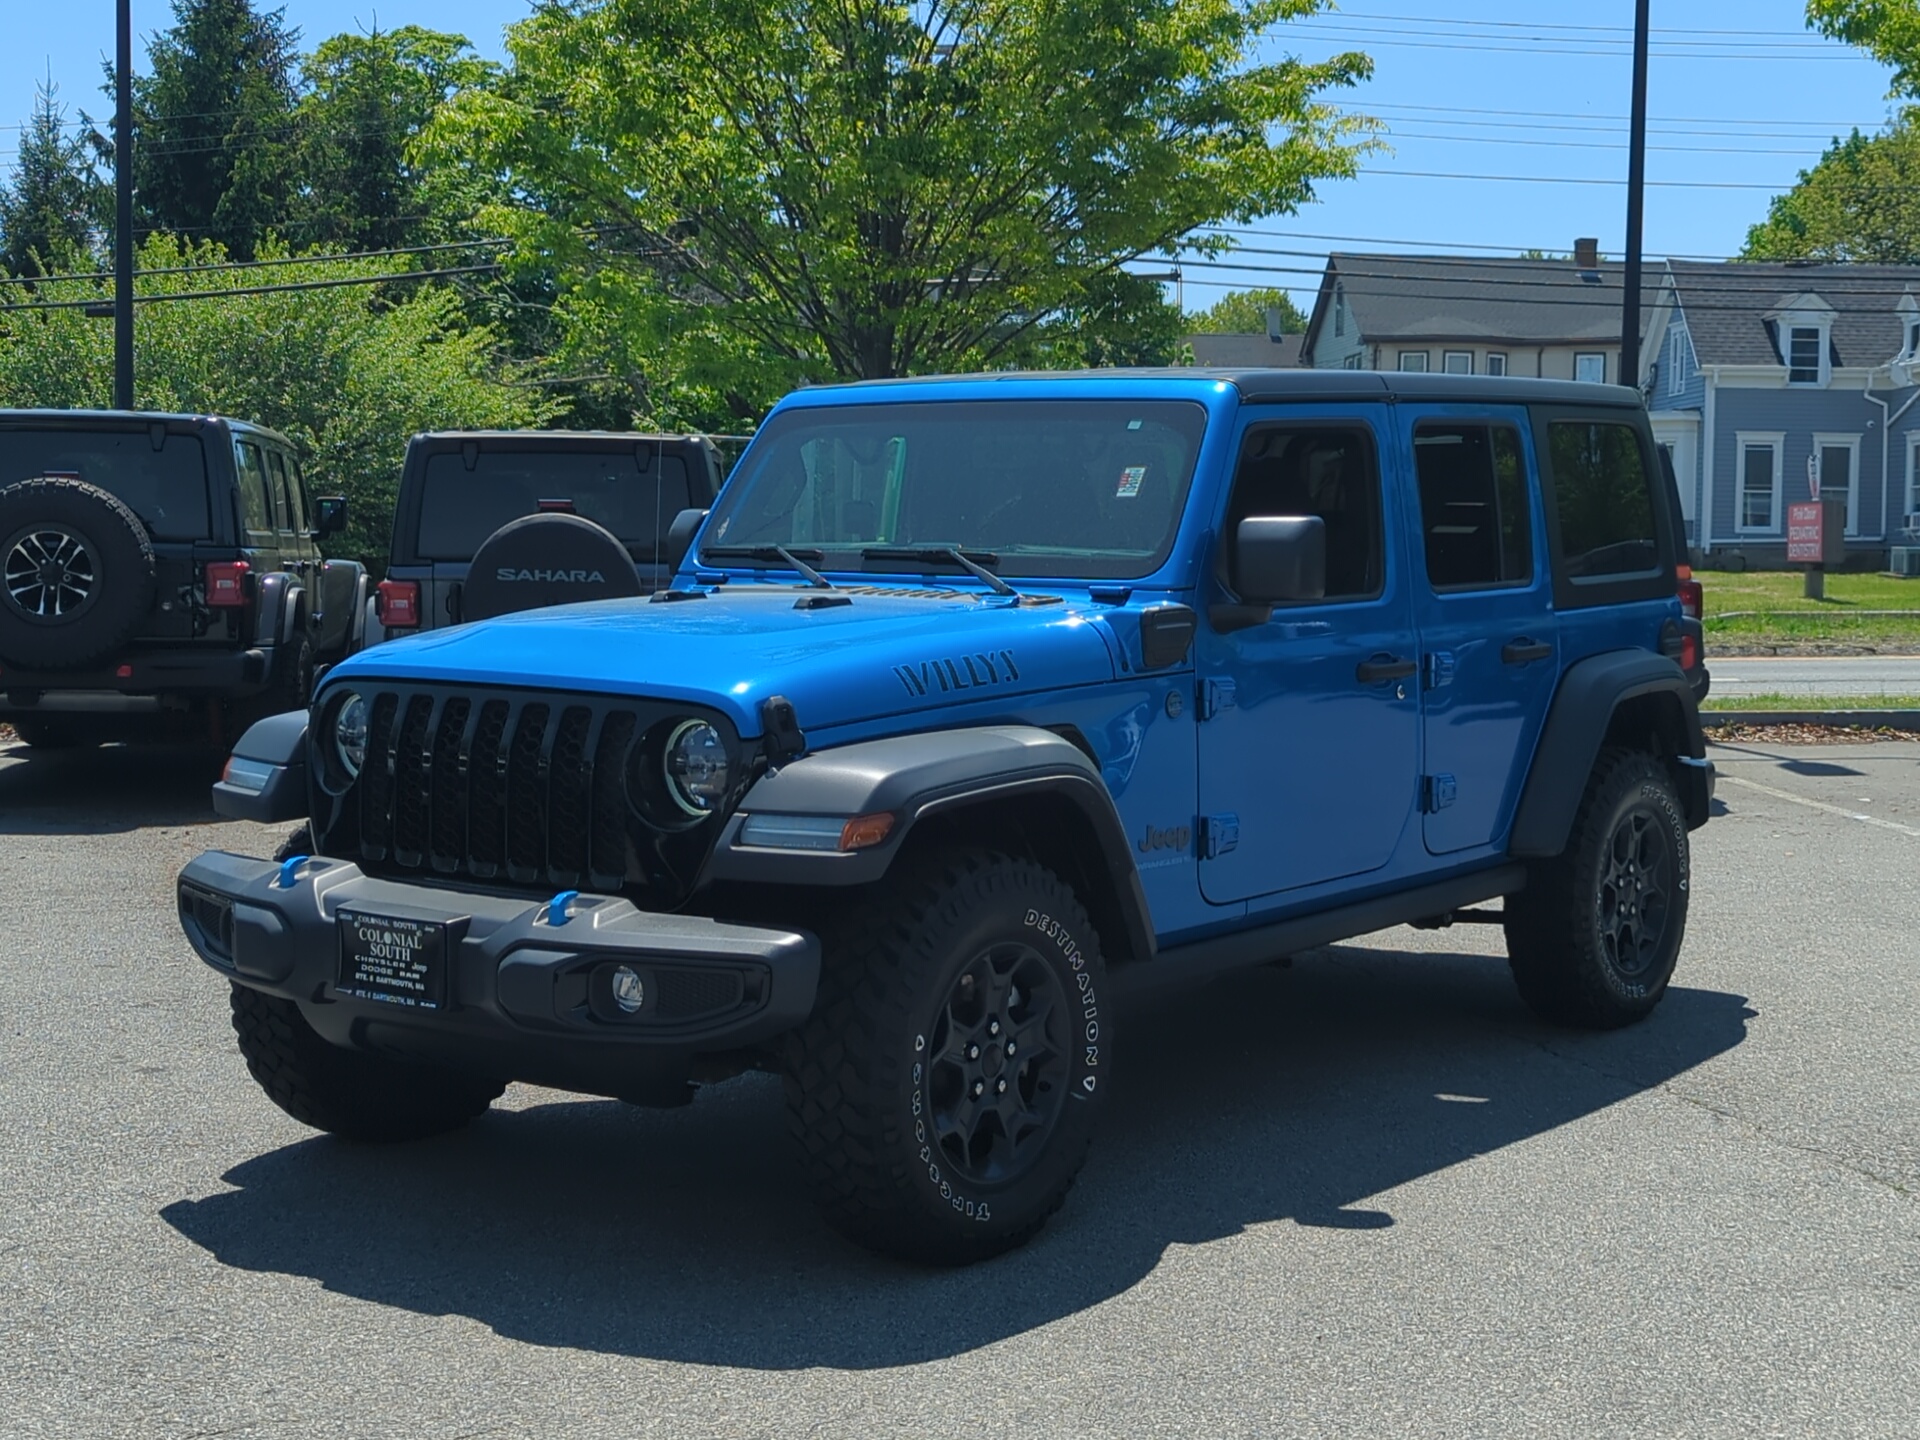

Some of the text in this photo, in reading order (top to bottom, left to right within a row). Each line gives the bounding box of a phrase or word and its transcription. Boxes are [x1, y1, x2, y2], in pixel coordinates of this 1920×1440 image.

[1789, 526, 1819, 540] PEDIATRIC
[1788, 543, 1819, 557] DENTISTRY
[496, 568, 606, 583] SAHARA
[892, 649, 1019, 697] WILLYS
[1138, 824, 1191, 853] Jeep
[358, 914, 390, 927] COLONIAL
[393, 921, 418, 930] SOUTH
[359, 927, 422, 950] COLONIAL
[370, 942, 411, 962] SOUTH
[354, 954, 428, 974] CHRYSLER Jeep
[361, 963, 420, 980] DODGE RAM
[415, 982, 425, 991] MA
[1023, 908, 1099, 1066] DESTINATION
[406, 998, 415, 1006] MA
